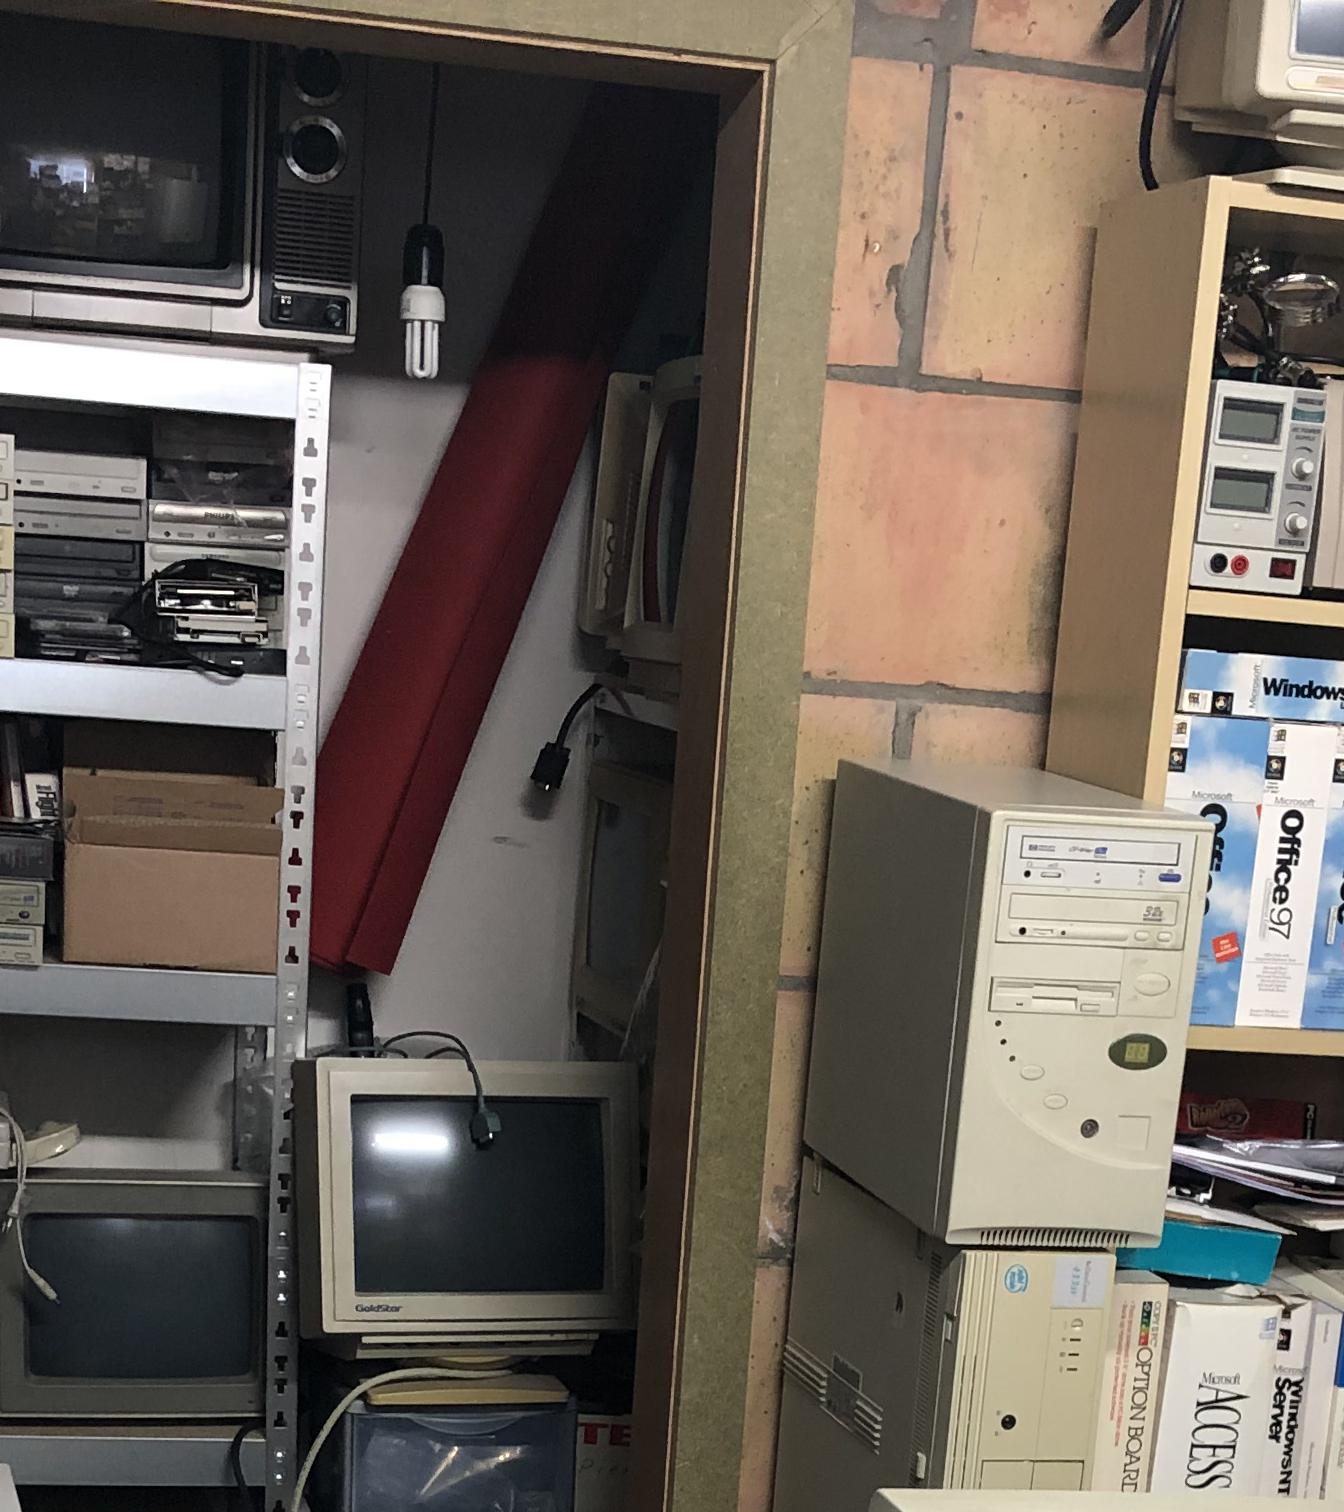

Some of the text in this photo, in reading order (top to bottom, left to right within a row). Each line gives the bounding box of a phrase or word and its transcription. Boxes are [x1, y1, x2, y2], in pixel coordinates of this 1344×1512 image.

[1249, 664, 1261, 709] Microsoft
[1192, 790, 1233, 801] Microsoft
[1274, 796, 1315, 807] Microsoft
[1272, 809, 1304, 905] Office
[355, 1304, 403, 1312] GoldStar
[1129, 1346, 1153, 1422] OPTION
[1203, 1371, 1241, 1385] Microsoft
[1184, 1383, 1251, 1490] ACCESS
[1268, 1376, 1293, 1444] Server
[1277, 1376, 1306, 1497] Windows NT
